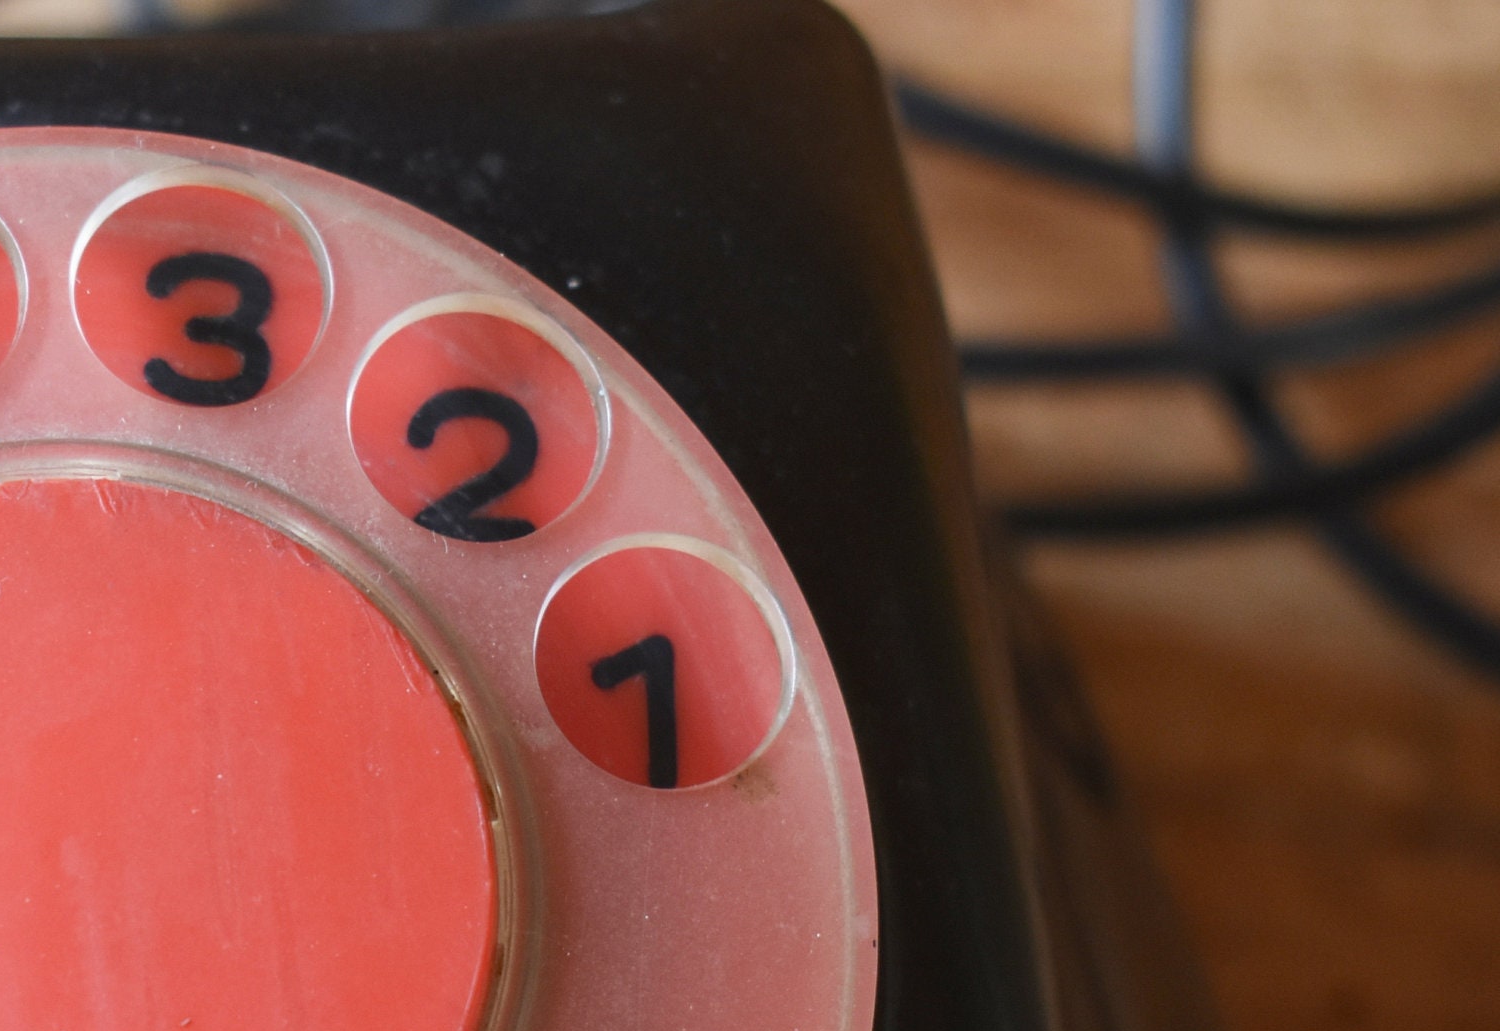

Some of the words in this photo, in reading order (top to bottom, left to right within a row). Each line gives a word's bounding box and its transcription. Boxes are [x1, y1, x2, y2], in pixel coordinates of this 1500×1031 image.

[145, 251, 273, 407] 3
[408, 387, 539, 543] 2
[591, 635, 678, 789] 1
